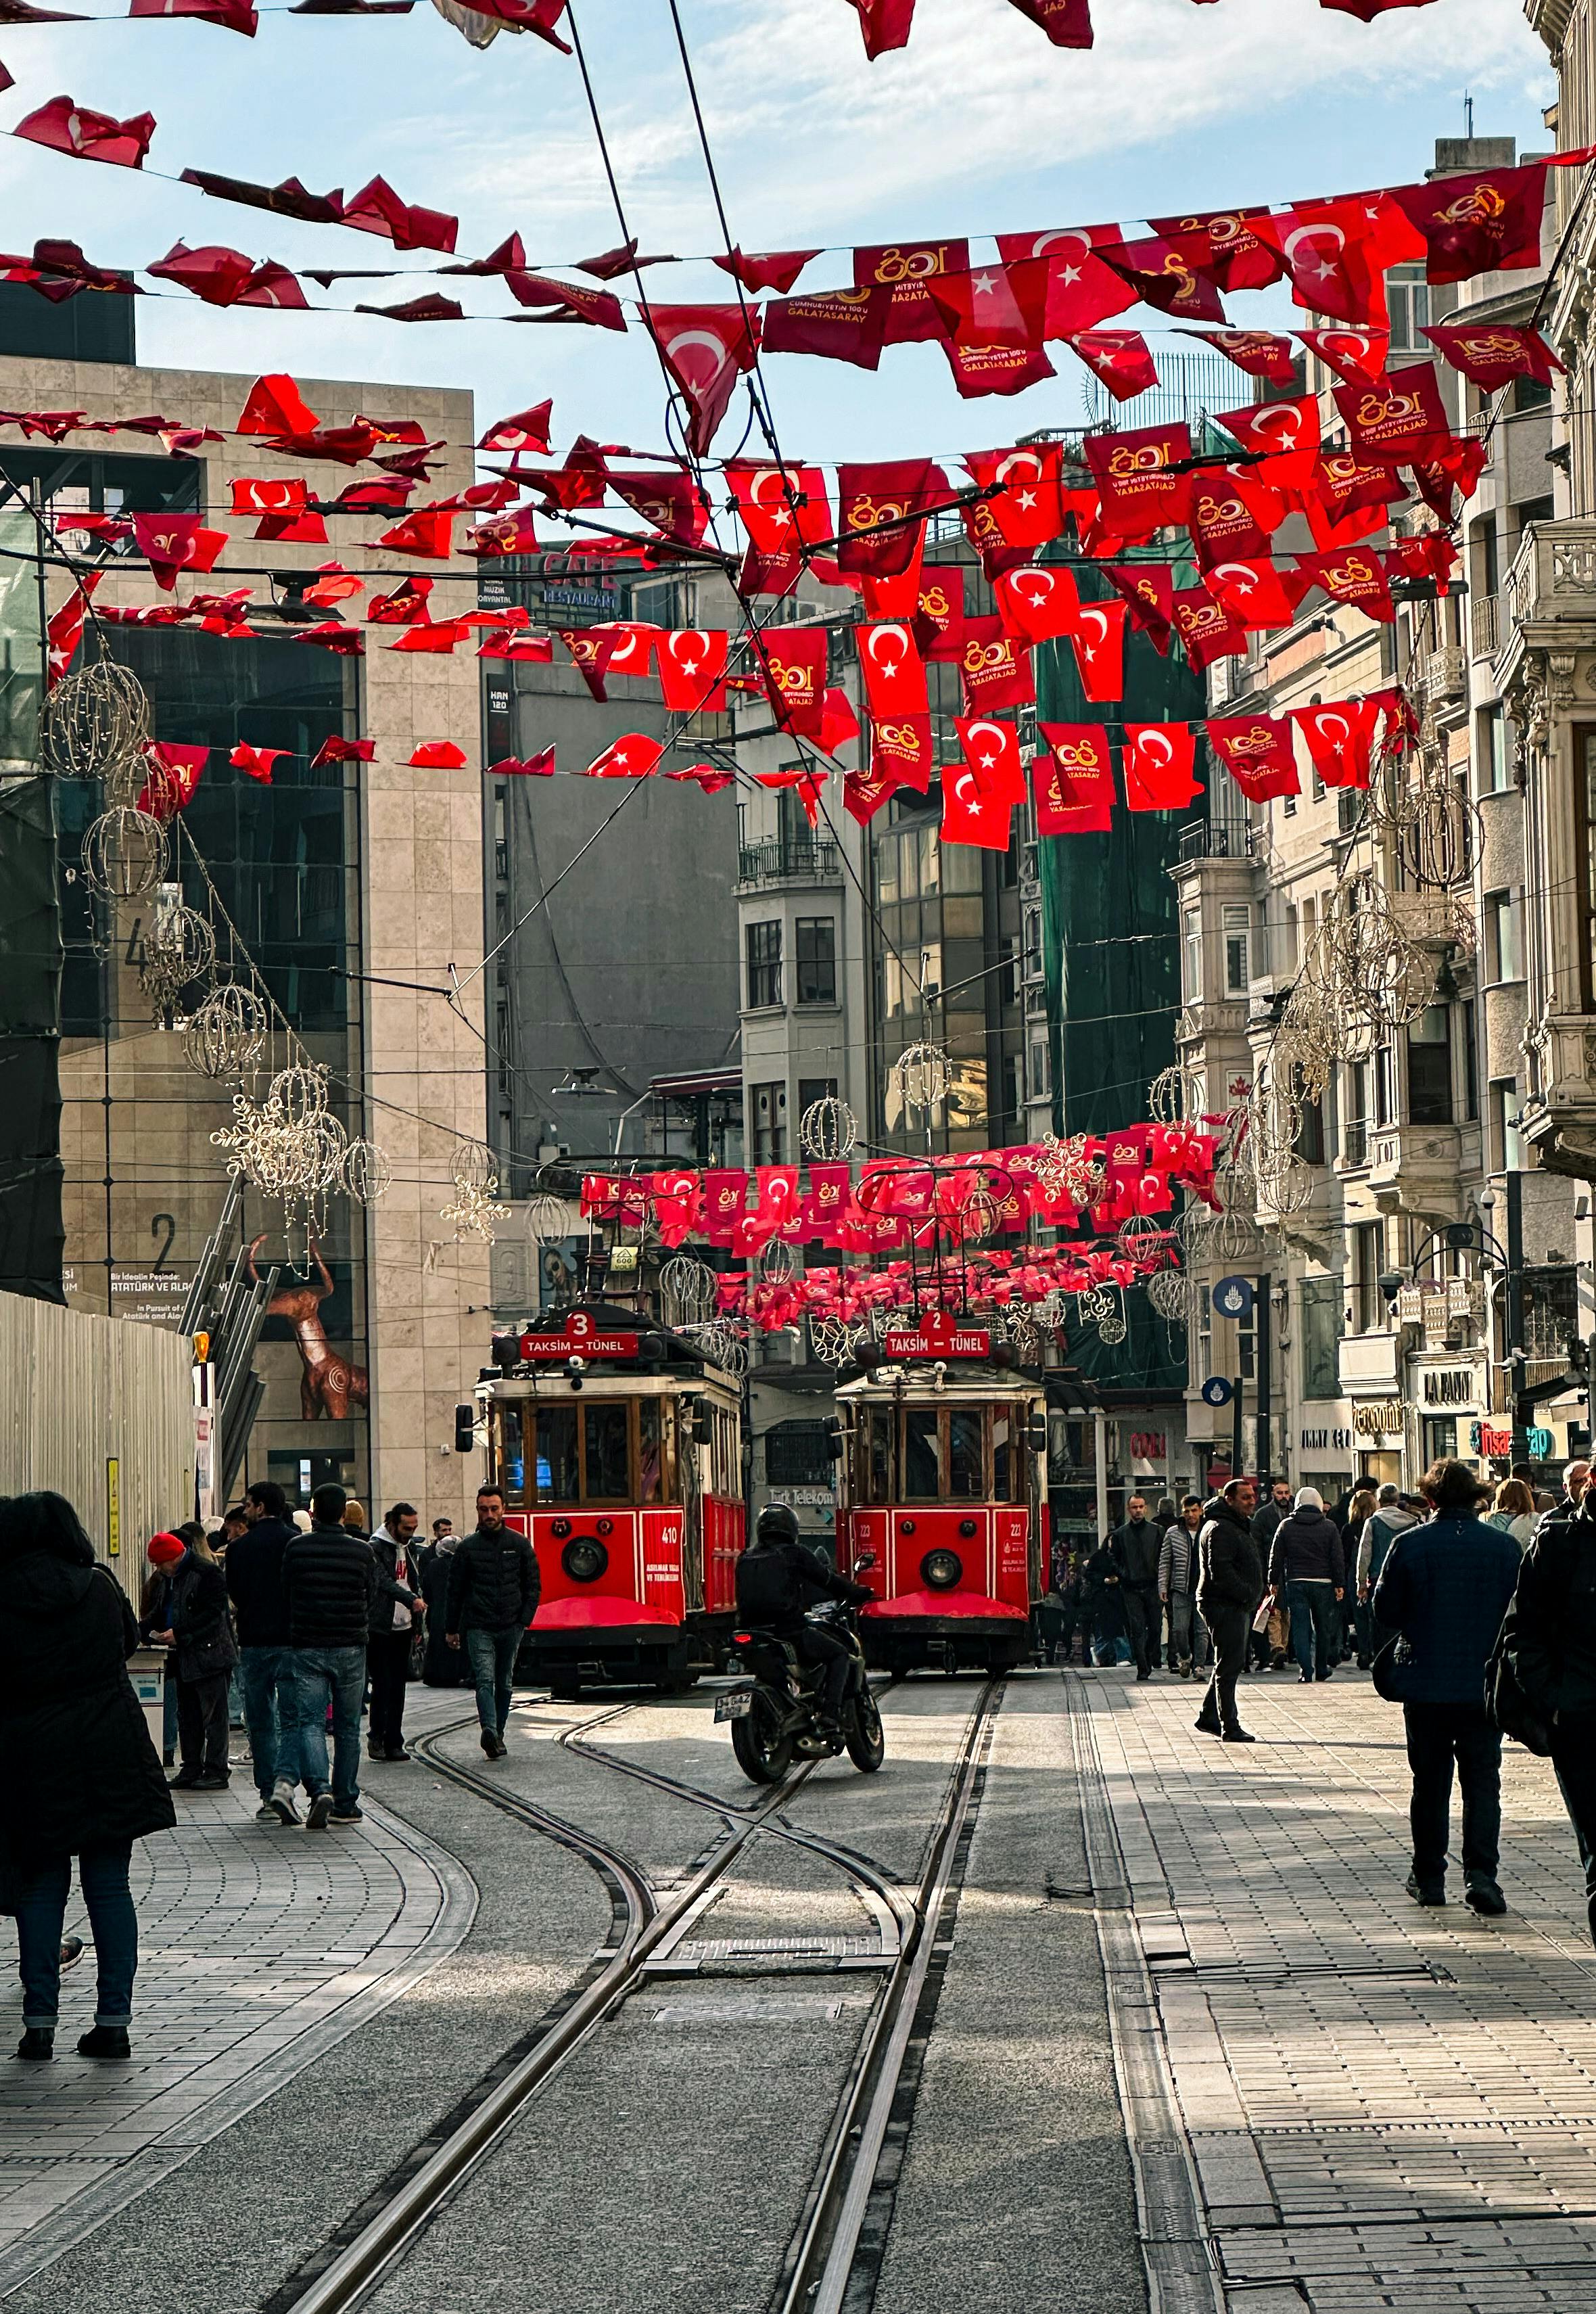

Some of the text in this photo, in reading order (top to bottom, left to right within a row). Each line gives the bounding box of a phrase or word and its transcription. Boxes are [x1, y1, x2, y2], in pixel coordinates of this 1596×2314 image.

[788, 308, 866, 323] GALATASARAY
[544, 553, 617, 590] CAFE
[490, 691, 509, 700] HAN
[492, 701, 507, 709] 120
[111, 1280, 154, 1291] ATATÜRK
[156, 1282, 169, 1291] VE
[573, 1314, 588, 1335] 3
[933, 1312, 941, 1328] 2
[527, 1339, 571, 1351] TAKSİM
[586, 1339, 624, 1351] TÜNEL
[890, 1334, 929, 1351] TAKSİM
[949, 1334, 983, 1351] TÜNEL
[793, 1489, 835, 1505] Telekom
[662, 1527, 677, 1544] 410
